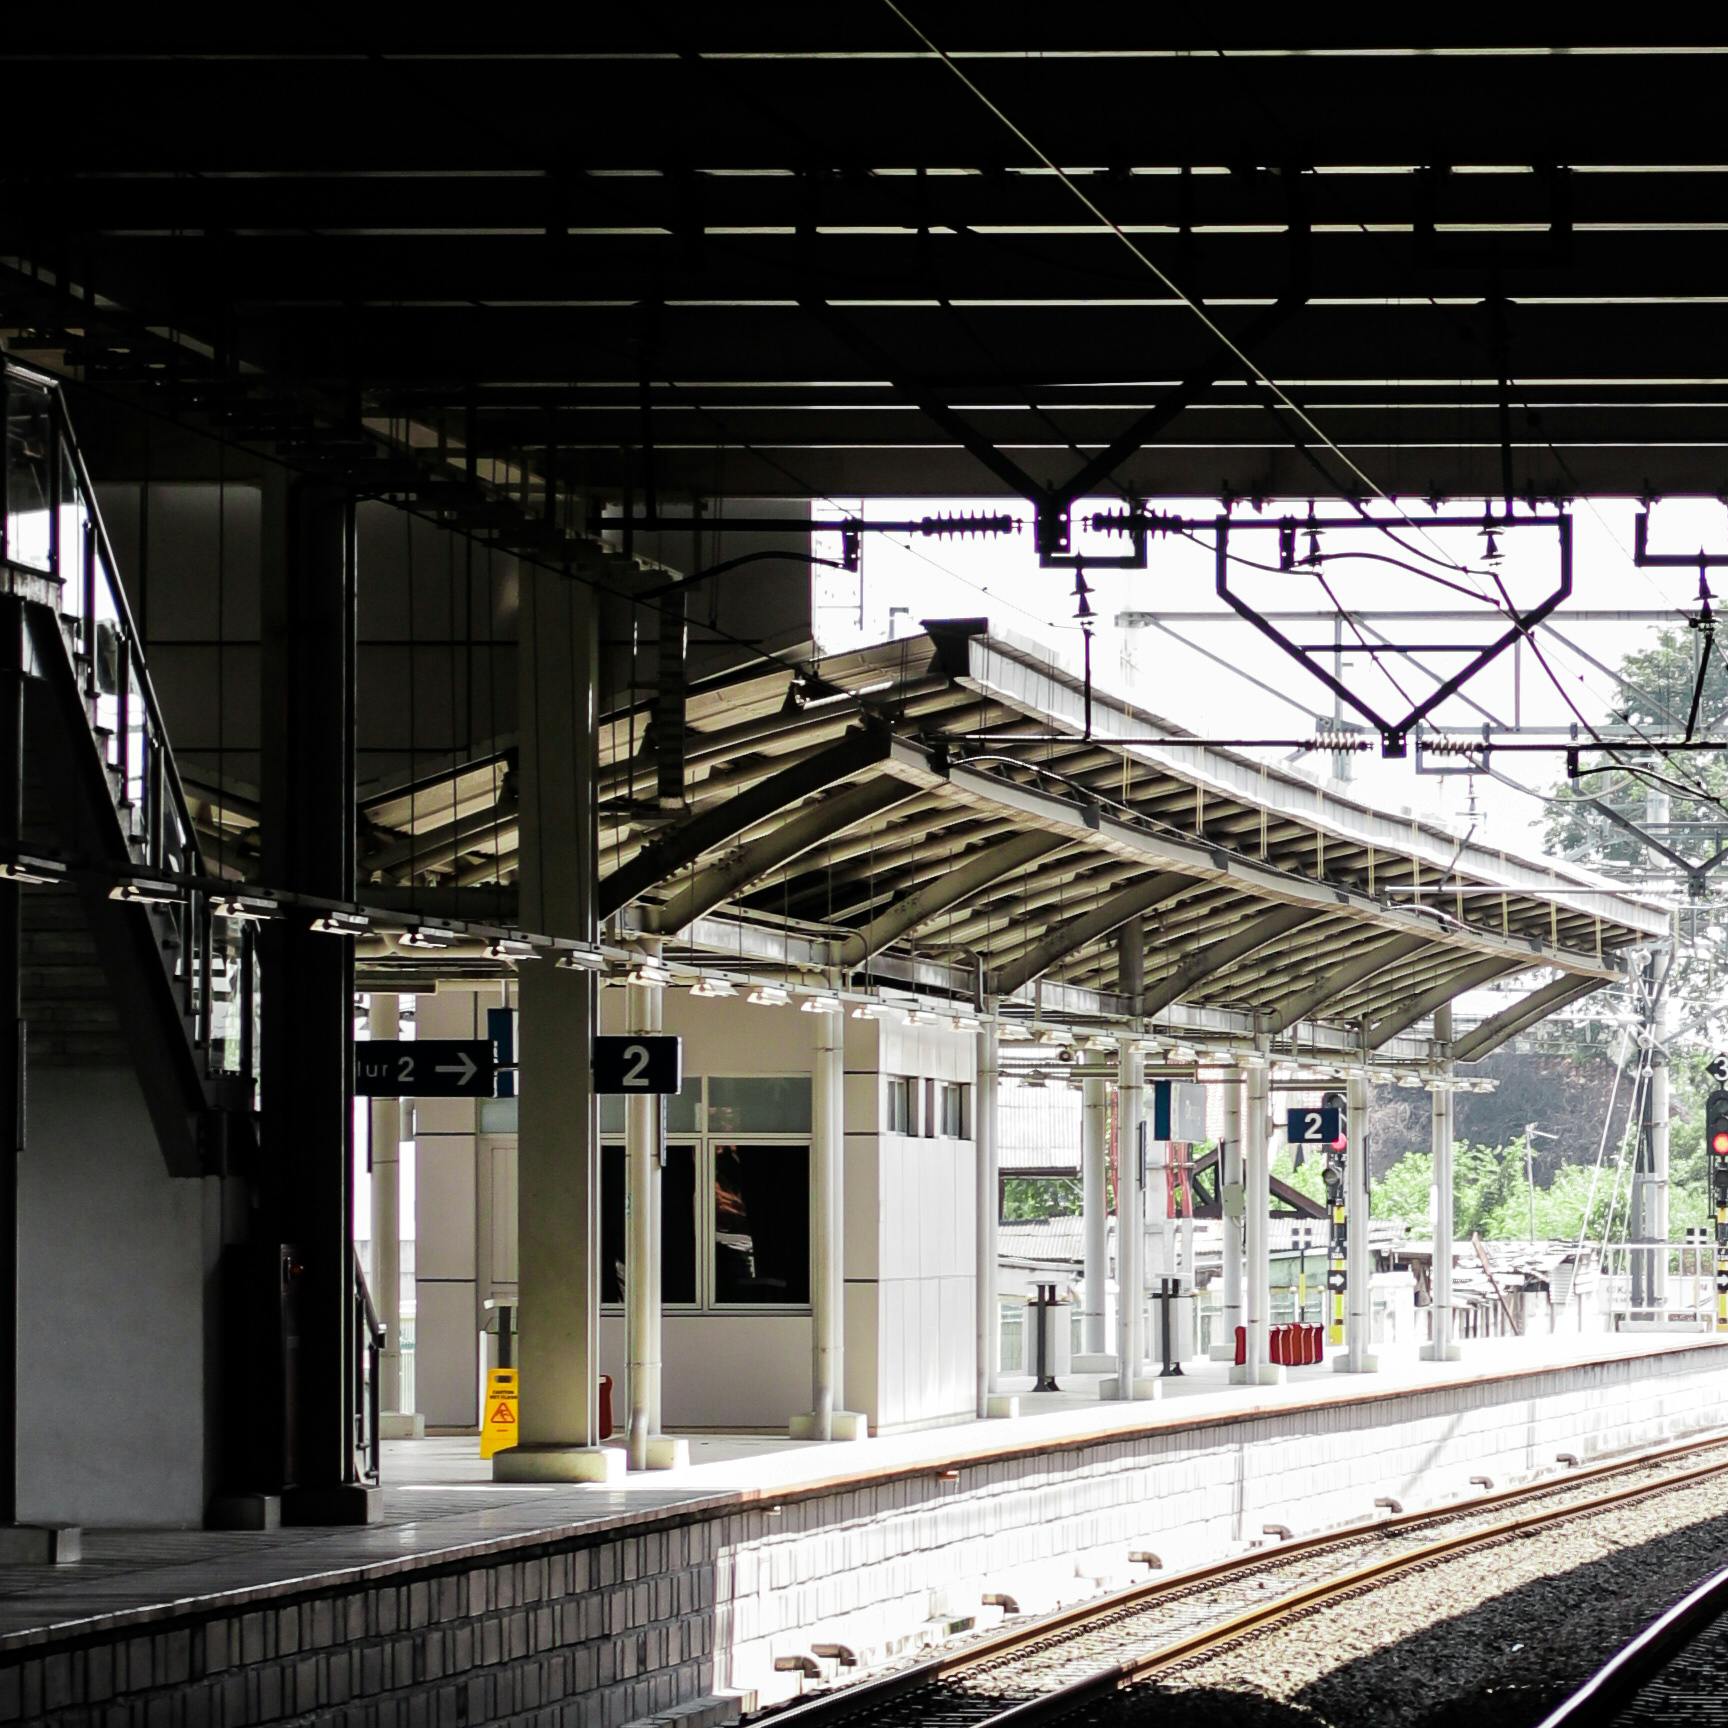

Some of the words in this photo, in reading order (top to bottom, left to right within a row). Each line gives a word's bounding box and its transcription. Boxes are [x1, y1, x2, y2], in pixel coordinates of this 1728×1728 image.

[357, 1061, 388, 1078] lur
[397, 1057, 414, 1082] 2
[622, 1045, 650, 1087] 2
[1304, 1112, 1323, 1140] 2
